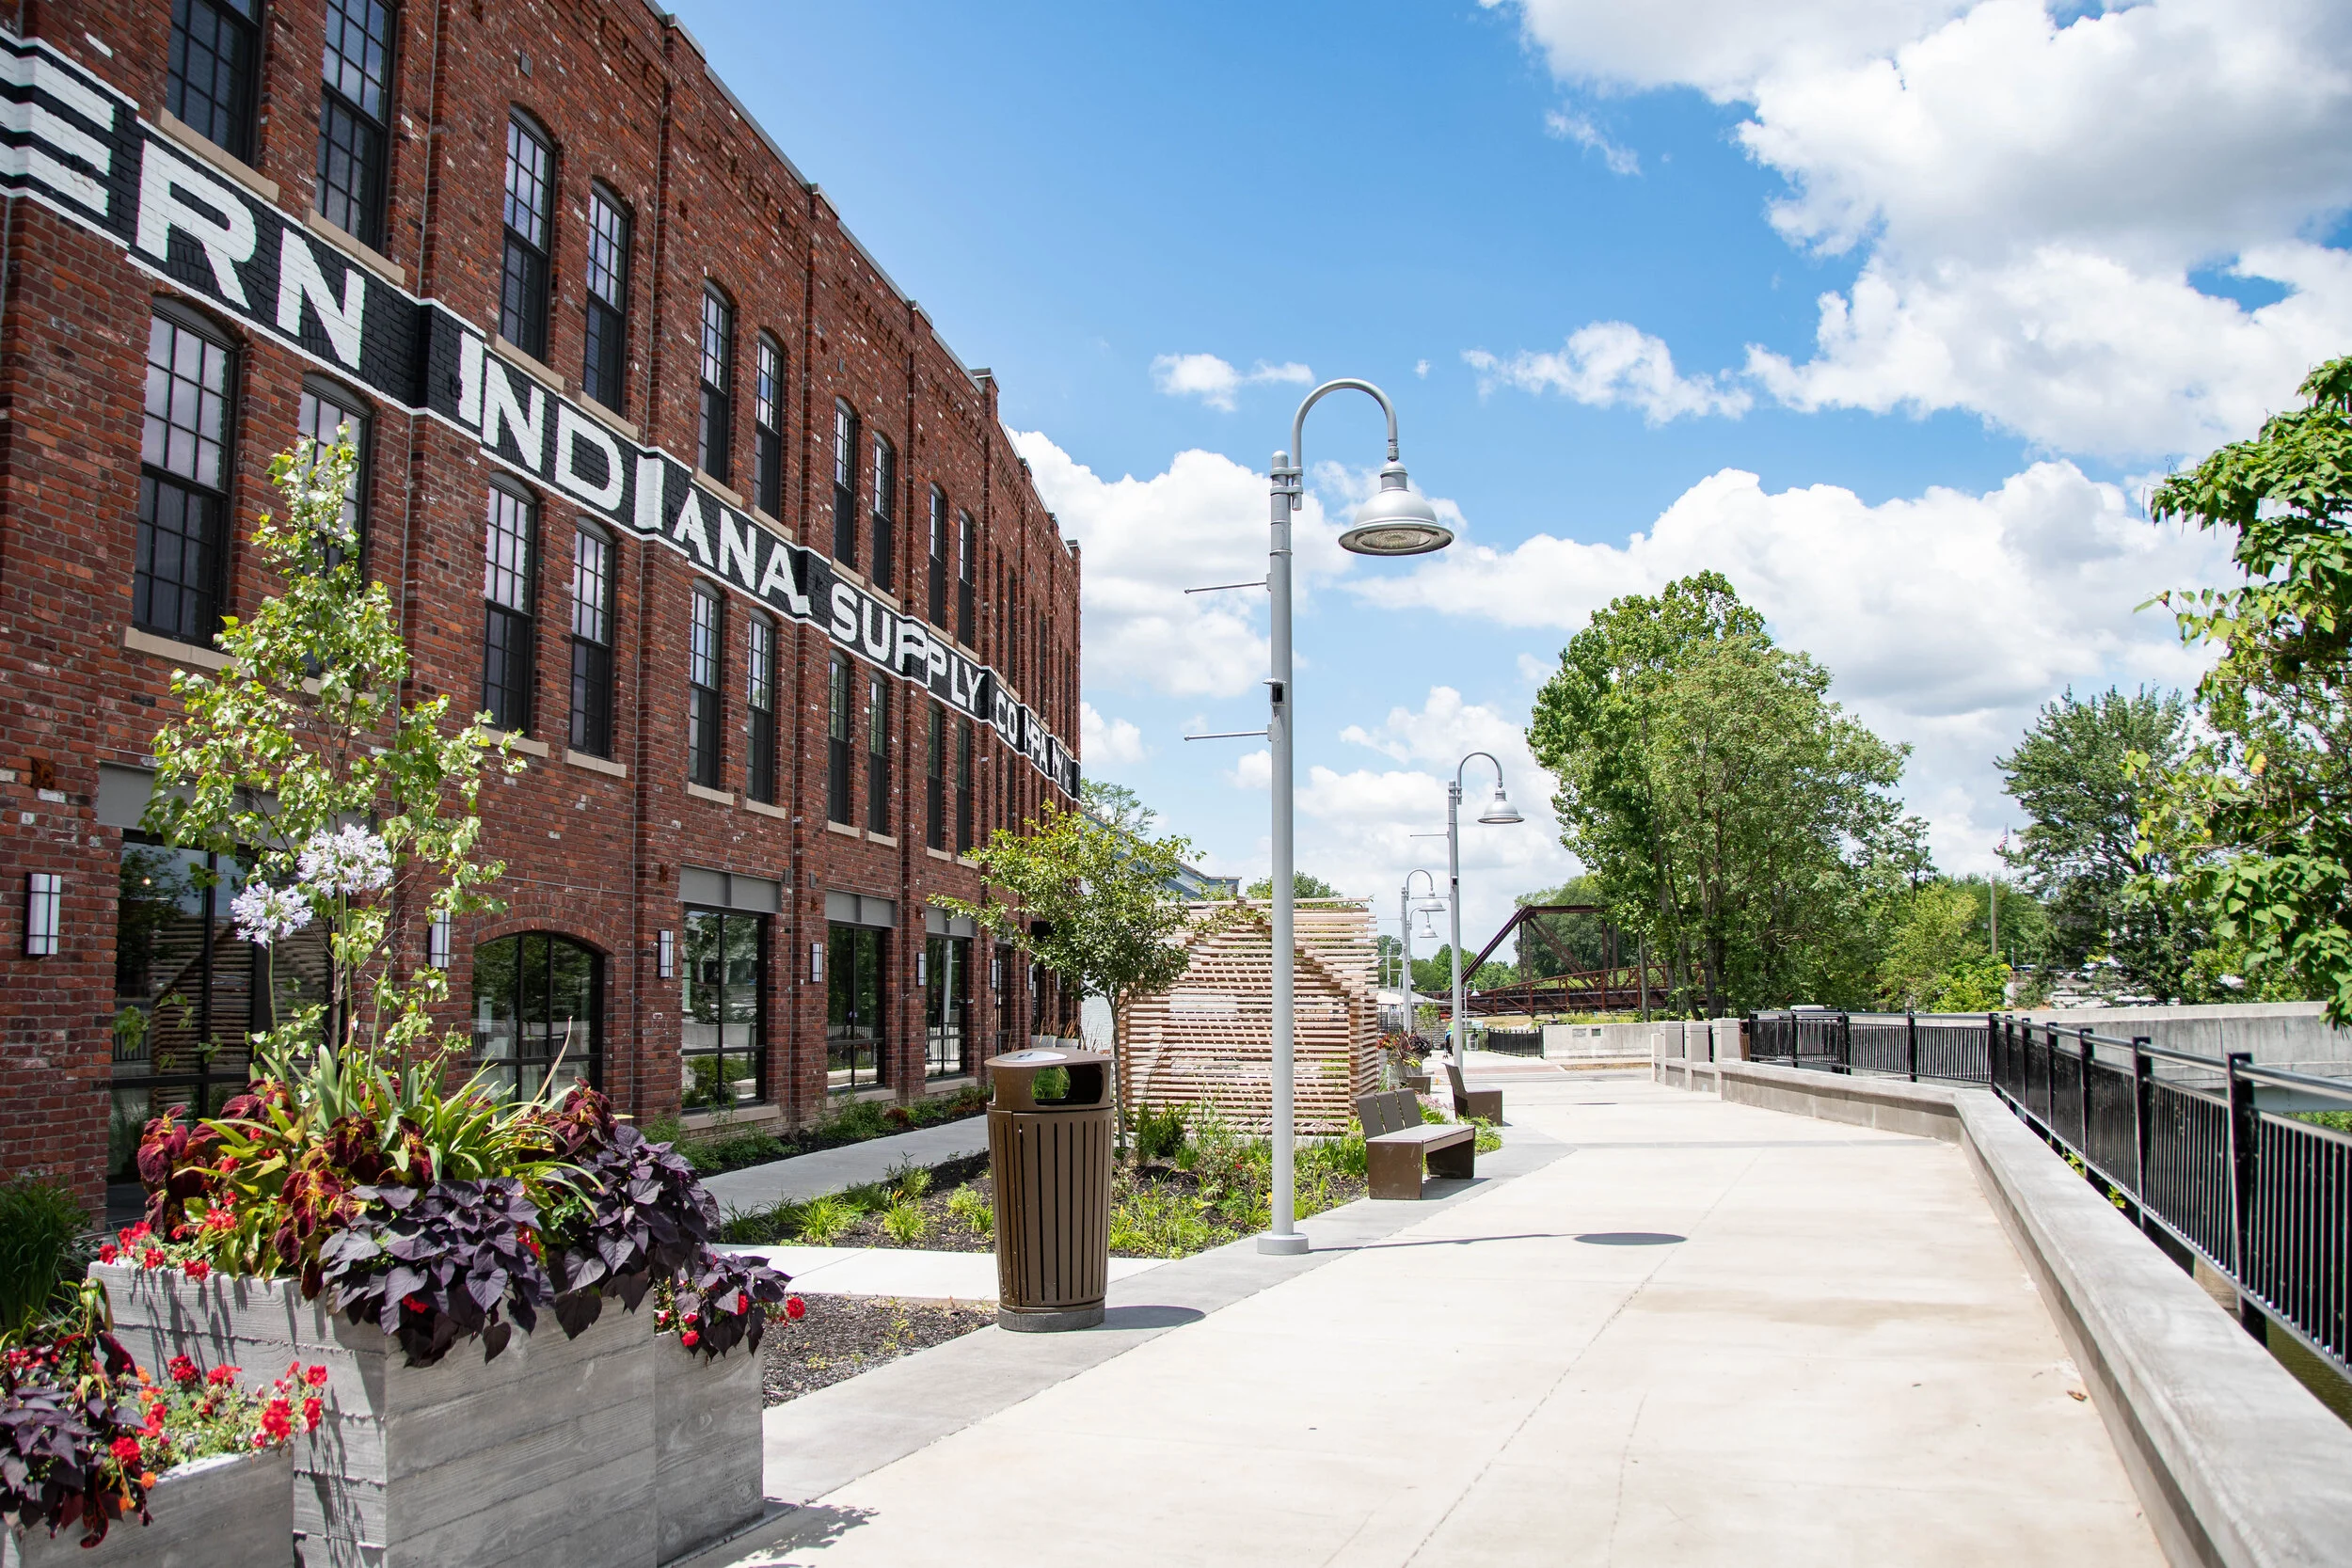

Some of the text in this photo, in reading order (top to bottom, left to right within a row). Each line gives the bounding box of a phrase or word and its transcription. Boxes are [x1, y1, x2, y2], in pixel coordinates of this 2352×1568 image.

[458, 330, 812, 617] INDIANA
[831, 582, 985, 712] SUPPLY
[995, 690, 1063, 785] COMPANY
